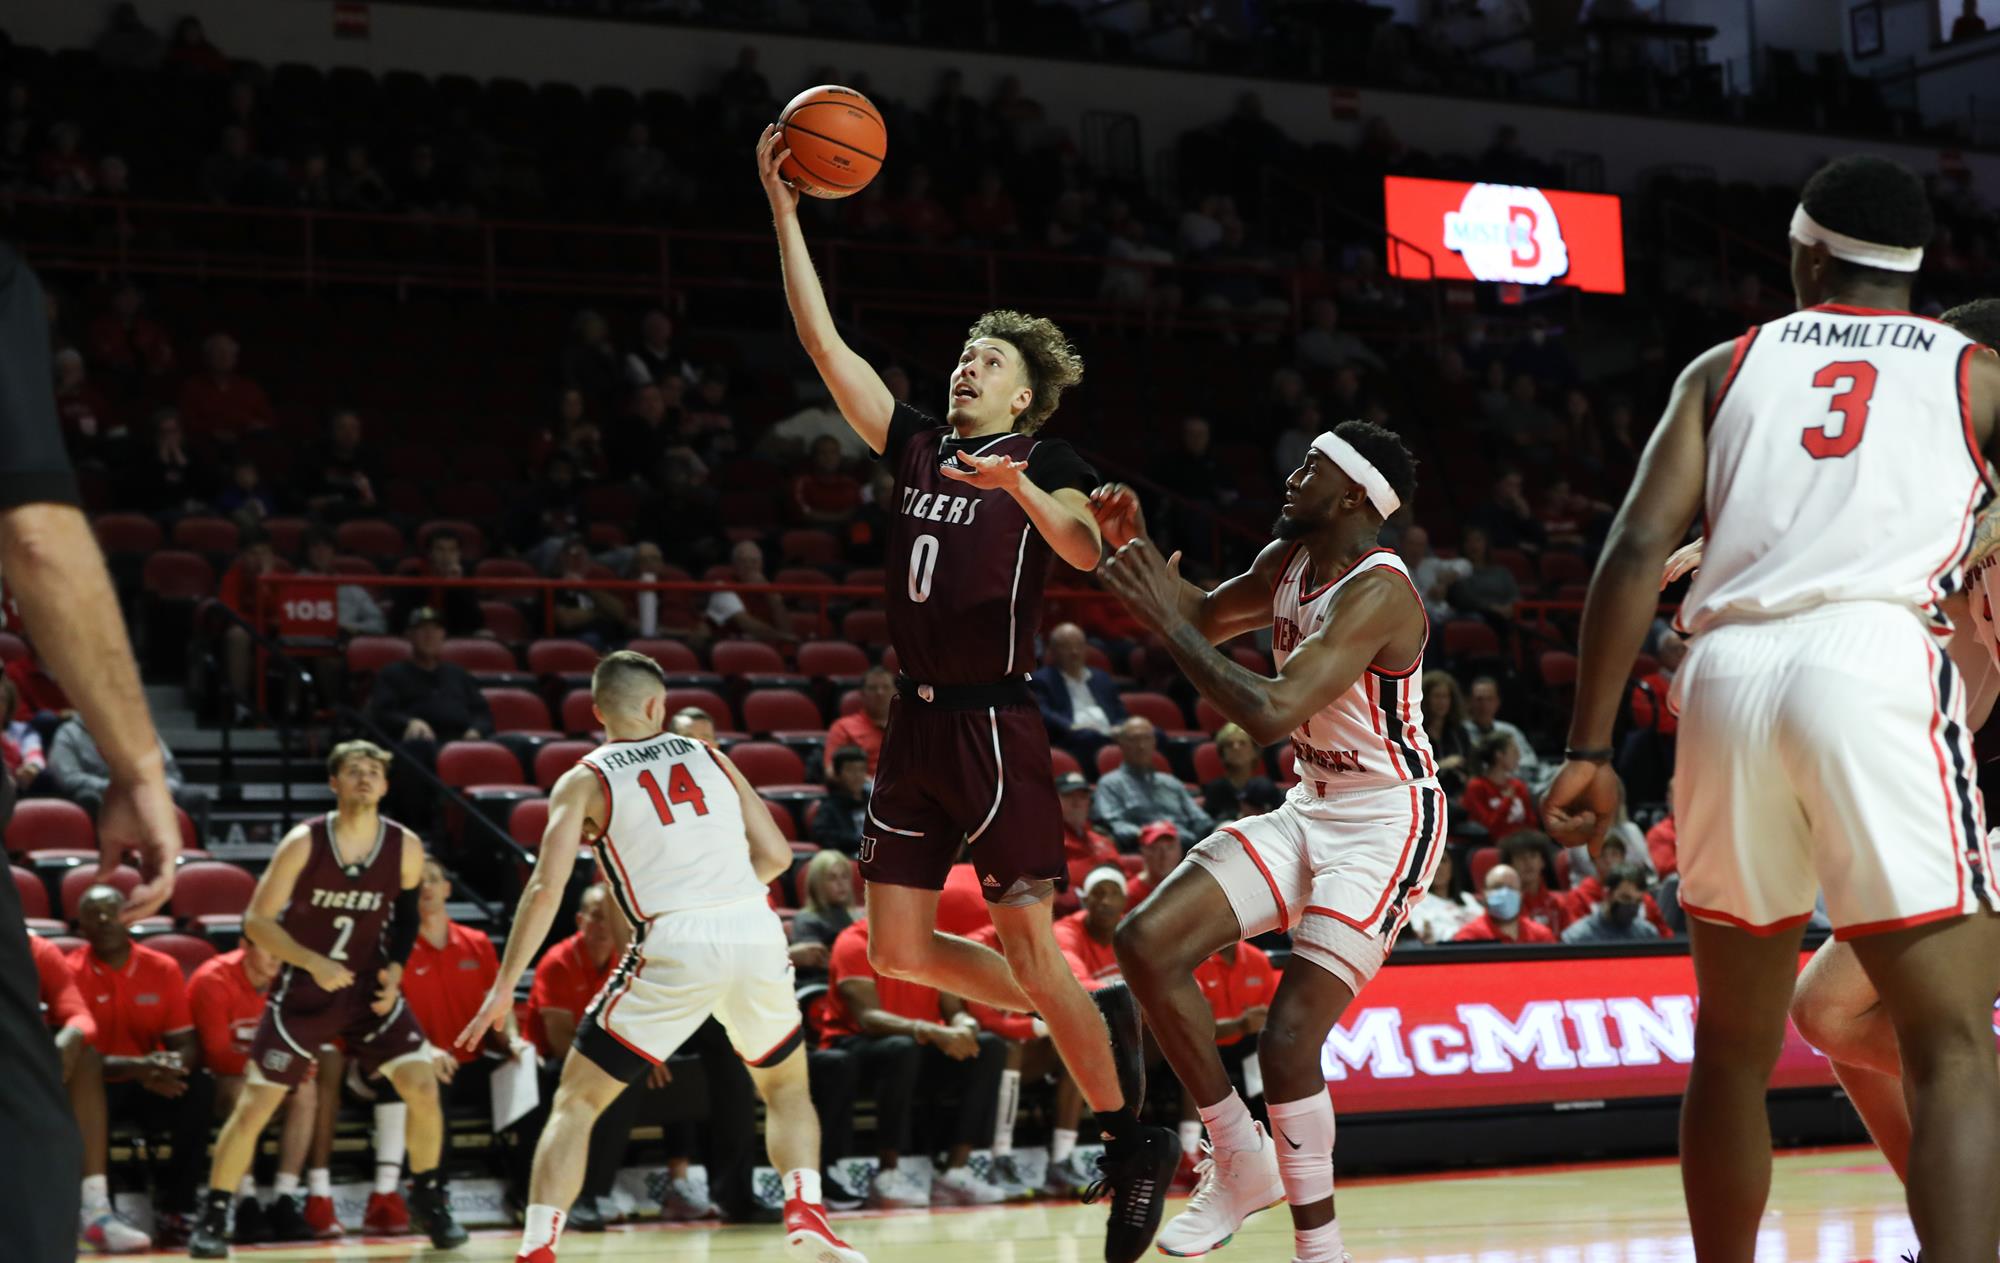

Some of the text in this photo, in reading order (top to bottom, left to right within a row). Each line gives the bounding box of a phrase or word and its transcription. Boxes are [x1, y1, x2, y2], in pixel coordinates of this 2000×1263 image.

[1780, 321, 1936, 352] HAMILTON
[1801, 360, 1879, 460] 3
[900, 486, 983, 526] TIGERS
[908, 533, 940, 603] 0
[283, 599, 334, 621] 105
[603, 738, 696, 771] FRAMPTON
[637, 762, 710, 826] 14
[311, 889, 384, 911] TIGERS
[329, 915, 355, 960] 2
[1321, 995, 1698, 1080] McMIN
